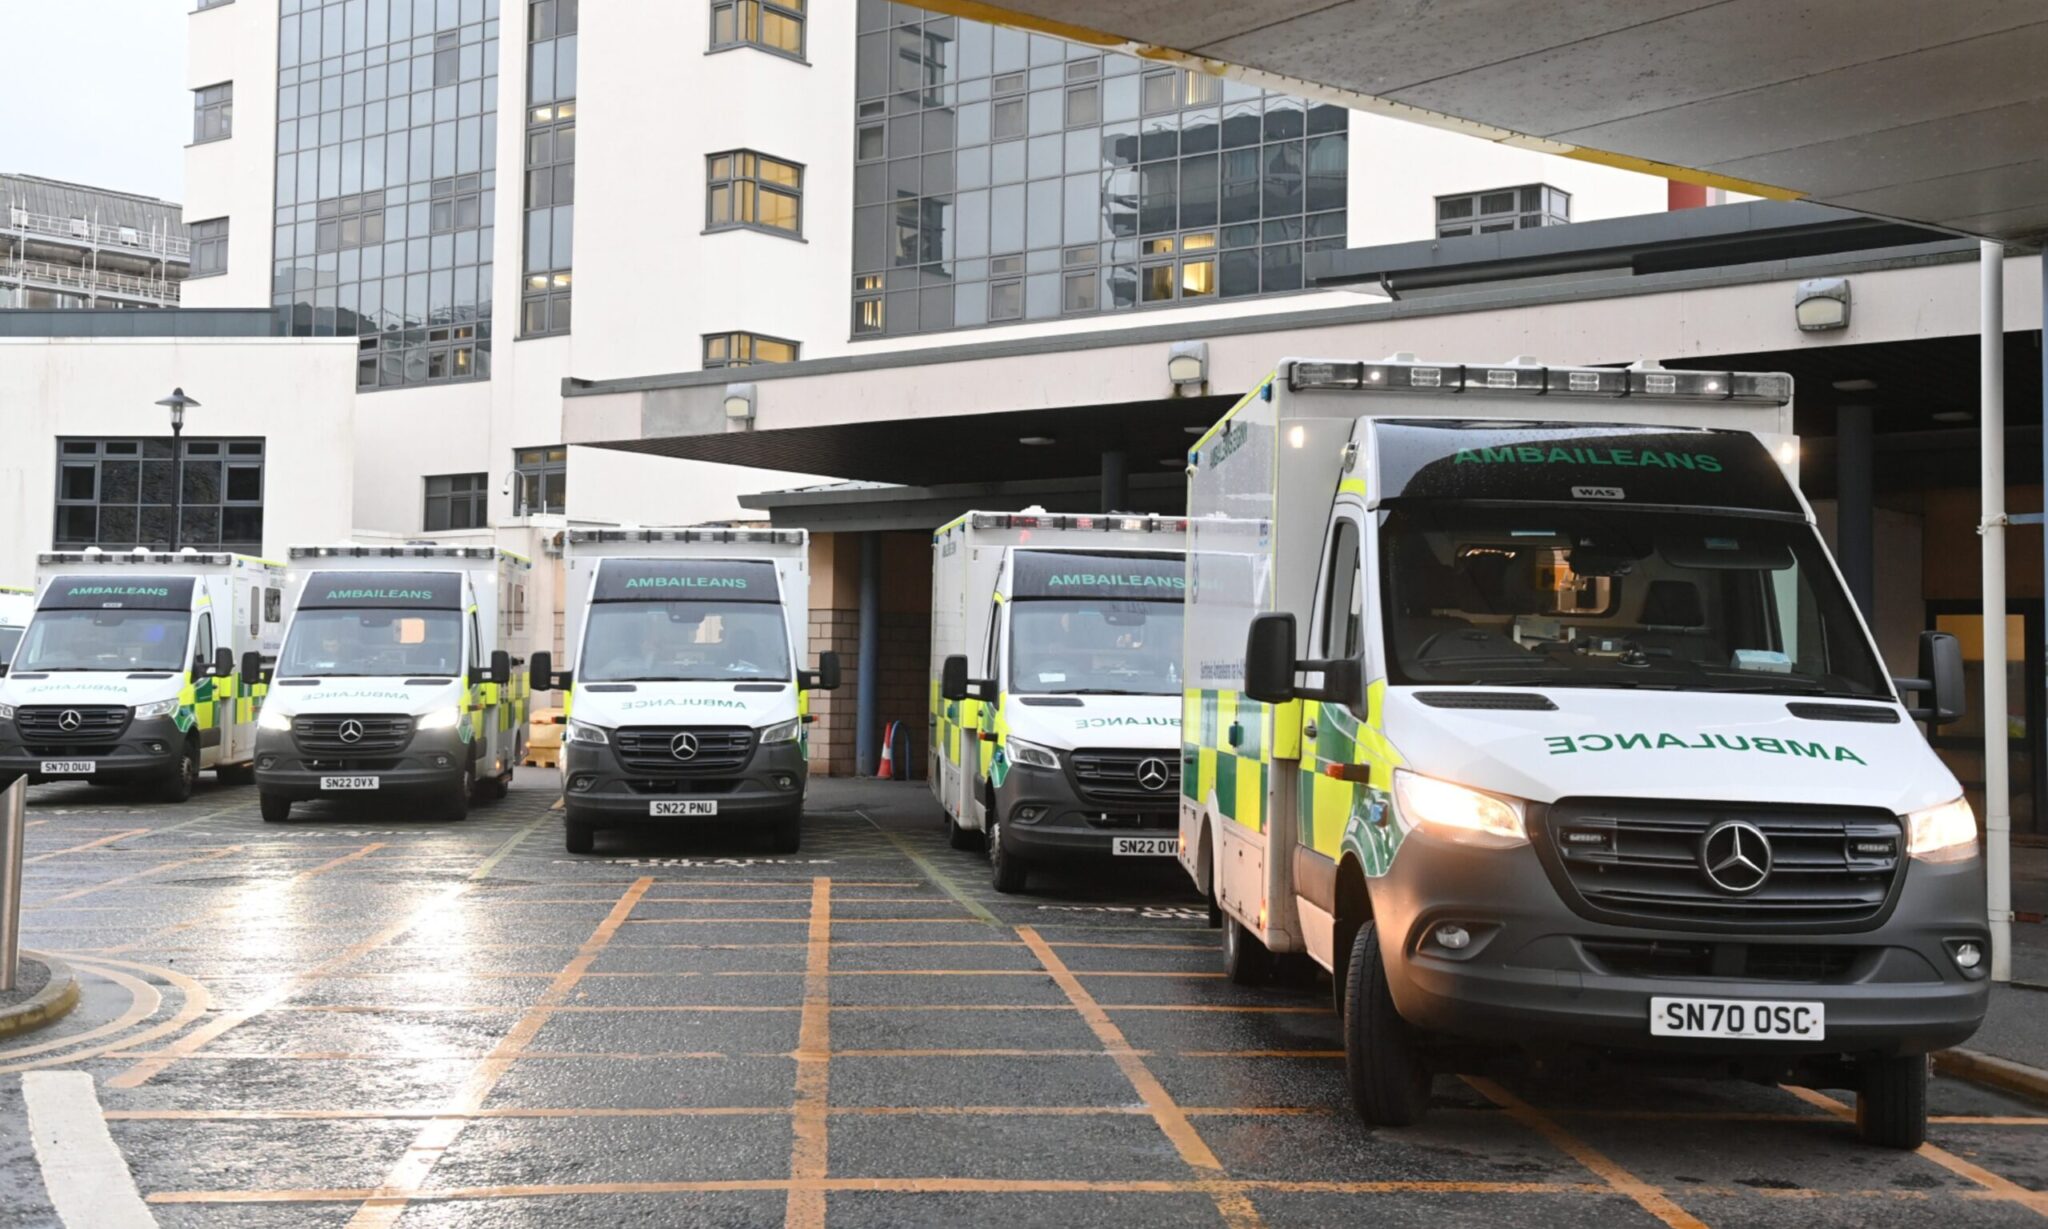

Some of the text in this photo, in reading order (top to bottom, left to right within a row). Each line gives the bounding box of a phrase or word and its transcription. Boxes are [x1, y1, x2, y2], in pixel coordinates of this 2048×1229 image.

[1454, 446, 1723, 473] AMBAILEANS
[1579, 488, 1617, 497] WAS
[625, 577, 748, 590] AMBAILEANS
[1048, 574, 1185, 589] AMBAILEANS
[67, 586, 169, 597] AMBAILEANS
[326, 589, 433, 600] AMBAILEANS
[45, 762, 70, 772] SN70
[326, 778, 374, 788] SN22 OVX
[656, 802, 712, 814] SN22 PNU
[1119, 840, 1179, 853] SN22 OV
[1666, 1004, 1810, 1033] SN70 OSC
